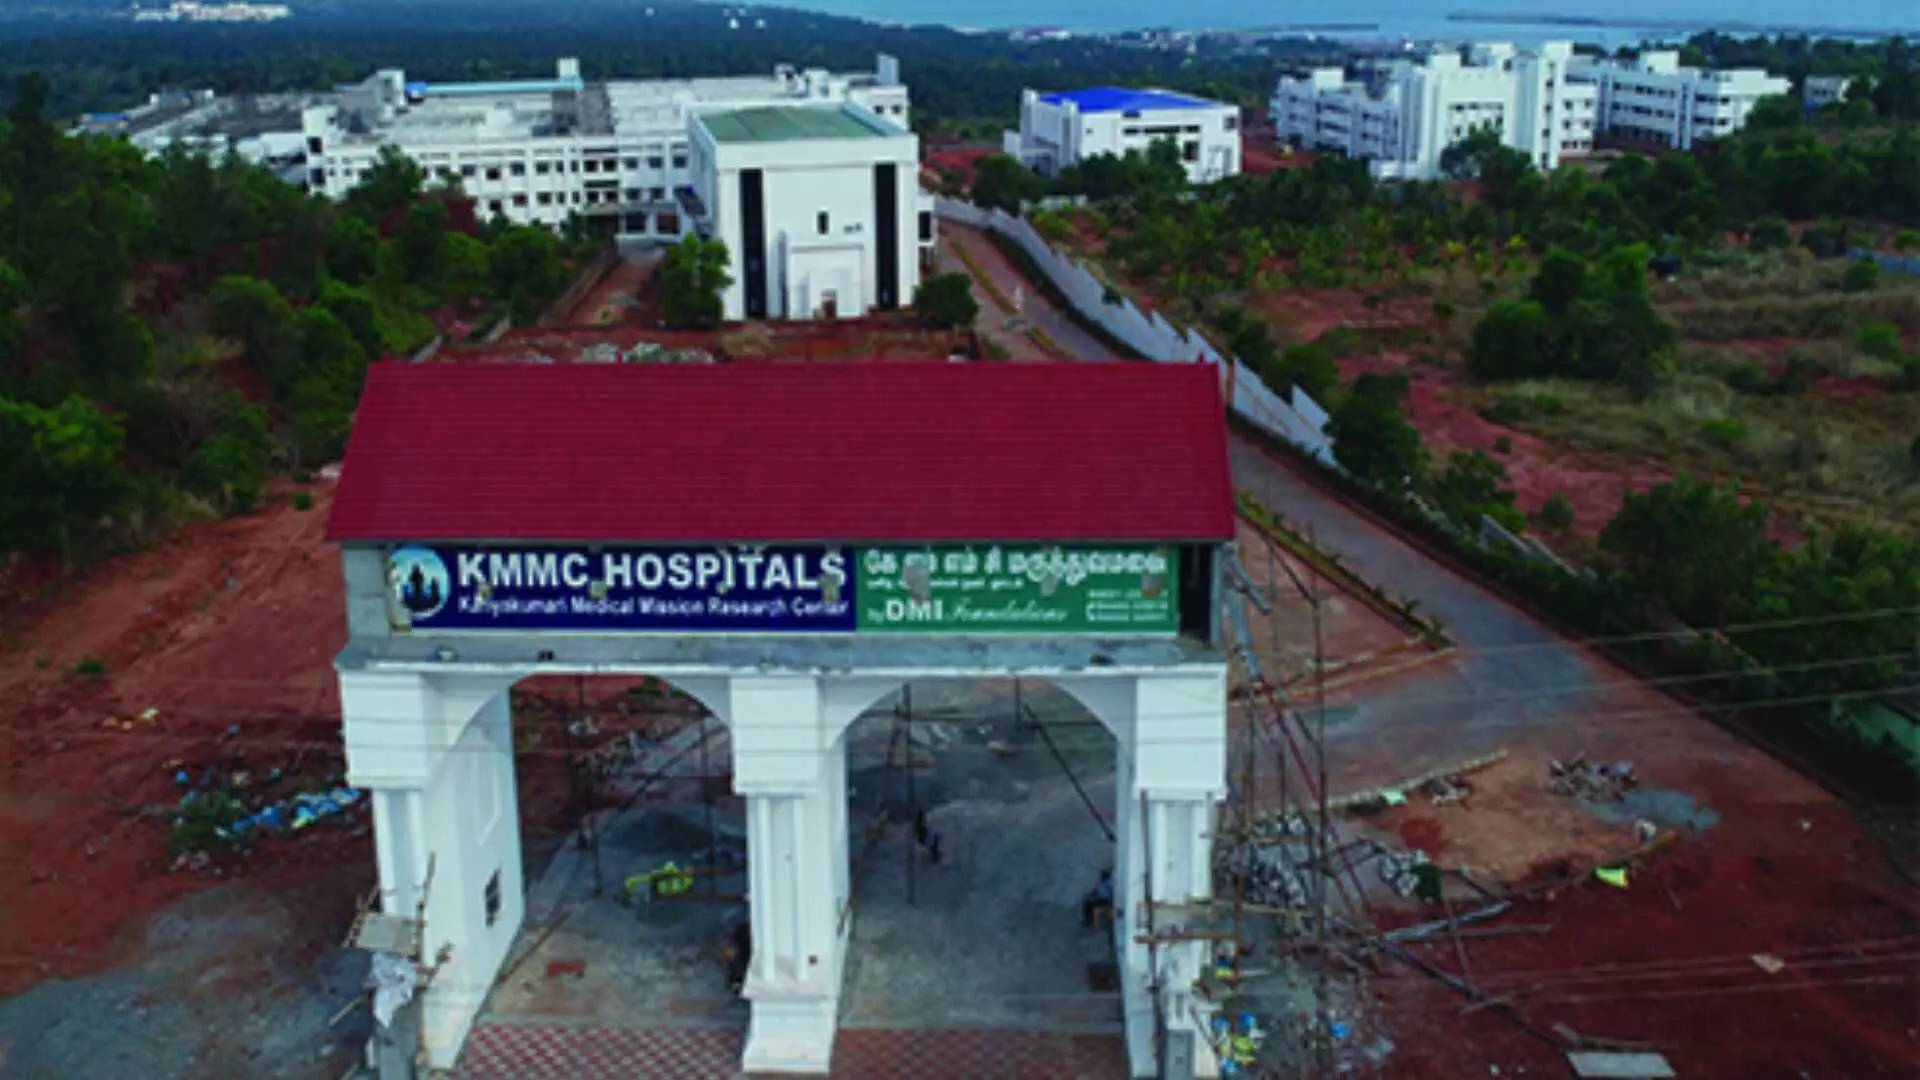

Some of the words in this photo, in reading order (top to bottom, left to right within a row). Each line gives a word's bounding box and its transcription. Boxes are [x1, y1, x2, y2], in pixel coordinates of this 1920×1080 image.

[457, 553, 588, 587] KMMC
[605, 553, 846, 589] HOSPITALS
[571, 596, 634, 614] Medical
[638, 597, 703, 614] Mission
[708, 597, 786, 616] Research
[886, 599, 943, 621] DMI
